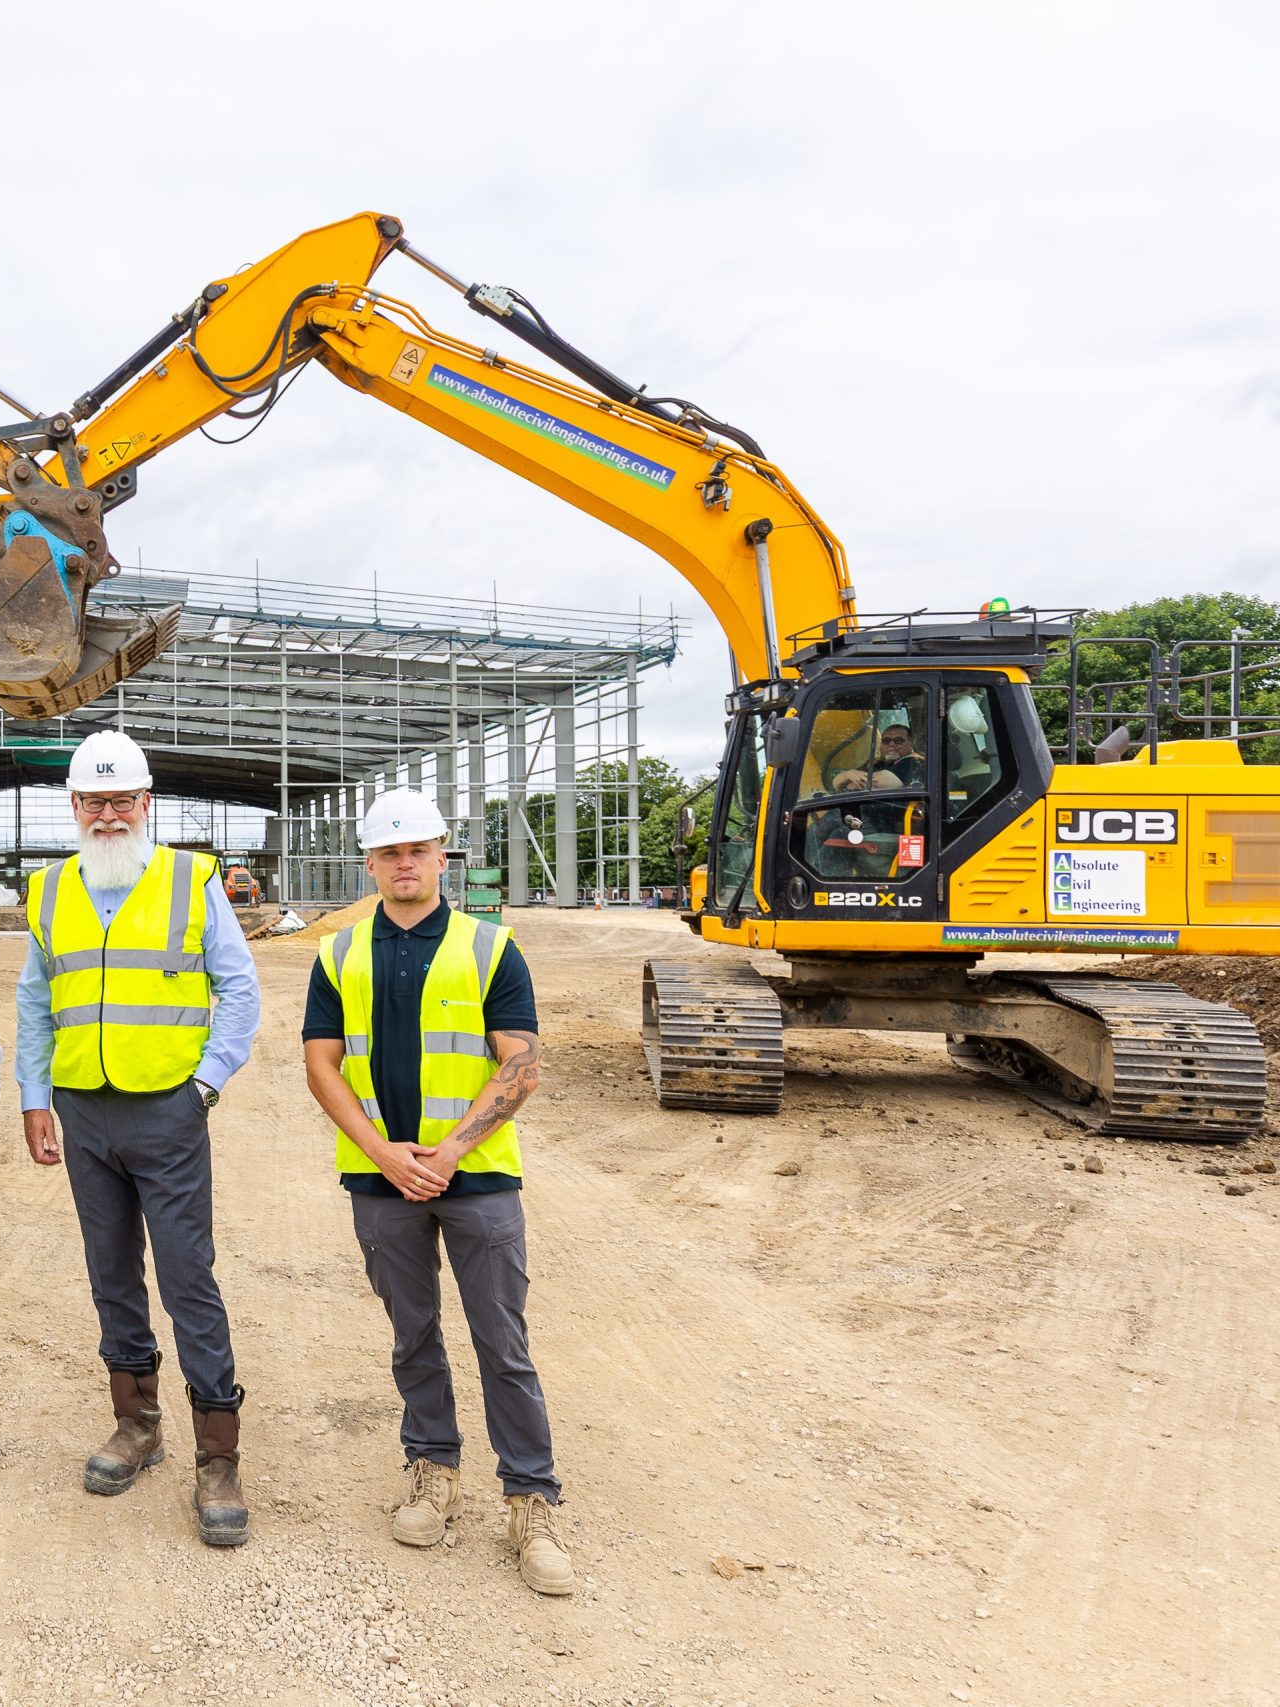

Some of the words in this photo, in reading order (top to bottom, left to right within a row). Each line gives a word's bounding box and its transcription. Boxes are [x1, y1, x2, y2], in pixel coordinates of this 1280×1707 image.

[433, 370, 668, 484] www.absolutecivilengineering.co.uk
[96, 763, 115, 774] UK
[1058, 811, 1176, 841] JCB
[1055, 854, 1119, 870] Absolute
[1055, 874, 1091, 890] Civil
[1057, 894, 1141, 914] Engineering
[946, 929, 1175, 945] www.absolutecivilengineering.co.uk
